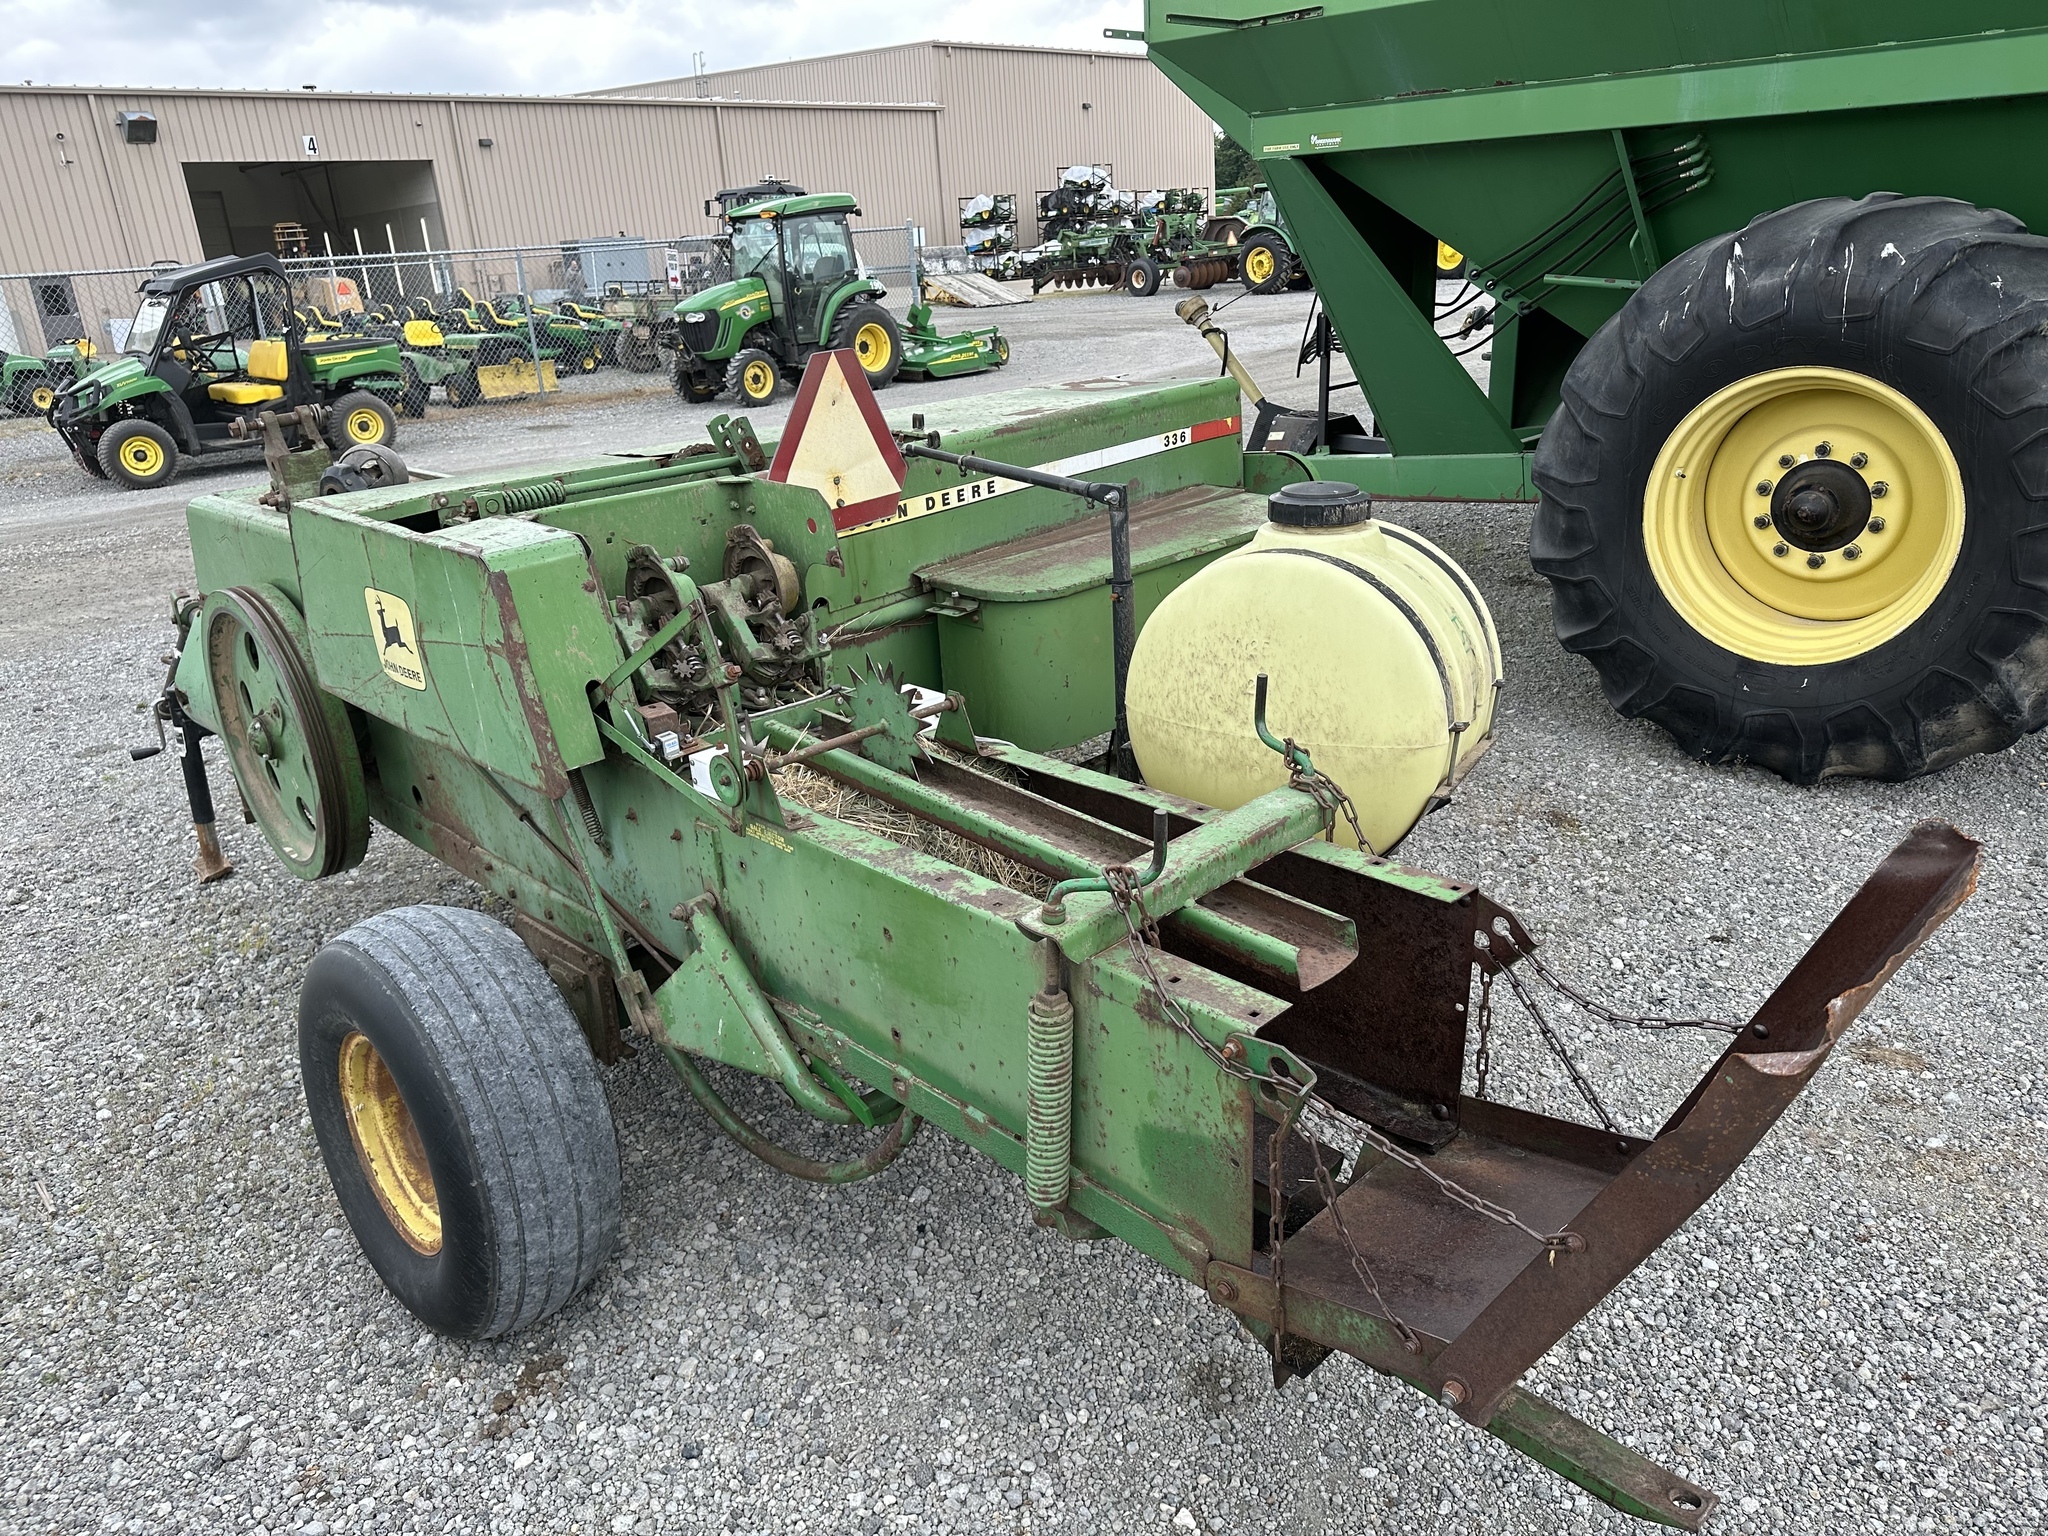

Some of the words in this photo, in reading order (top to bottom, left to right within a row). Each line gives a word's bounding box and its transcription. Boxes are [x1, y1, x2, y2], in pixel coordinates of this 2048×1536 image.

[308, 136, 317, 154] 4
[1164, 431, 1186, 447] 336
[925, 480, 996, 511] DEERE
[383, 658, 399, 673] JOHN
[399, 665, 422, 682] DEERE
